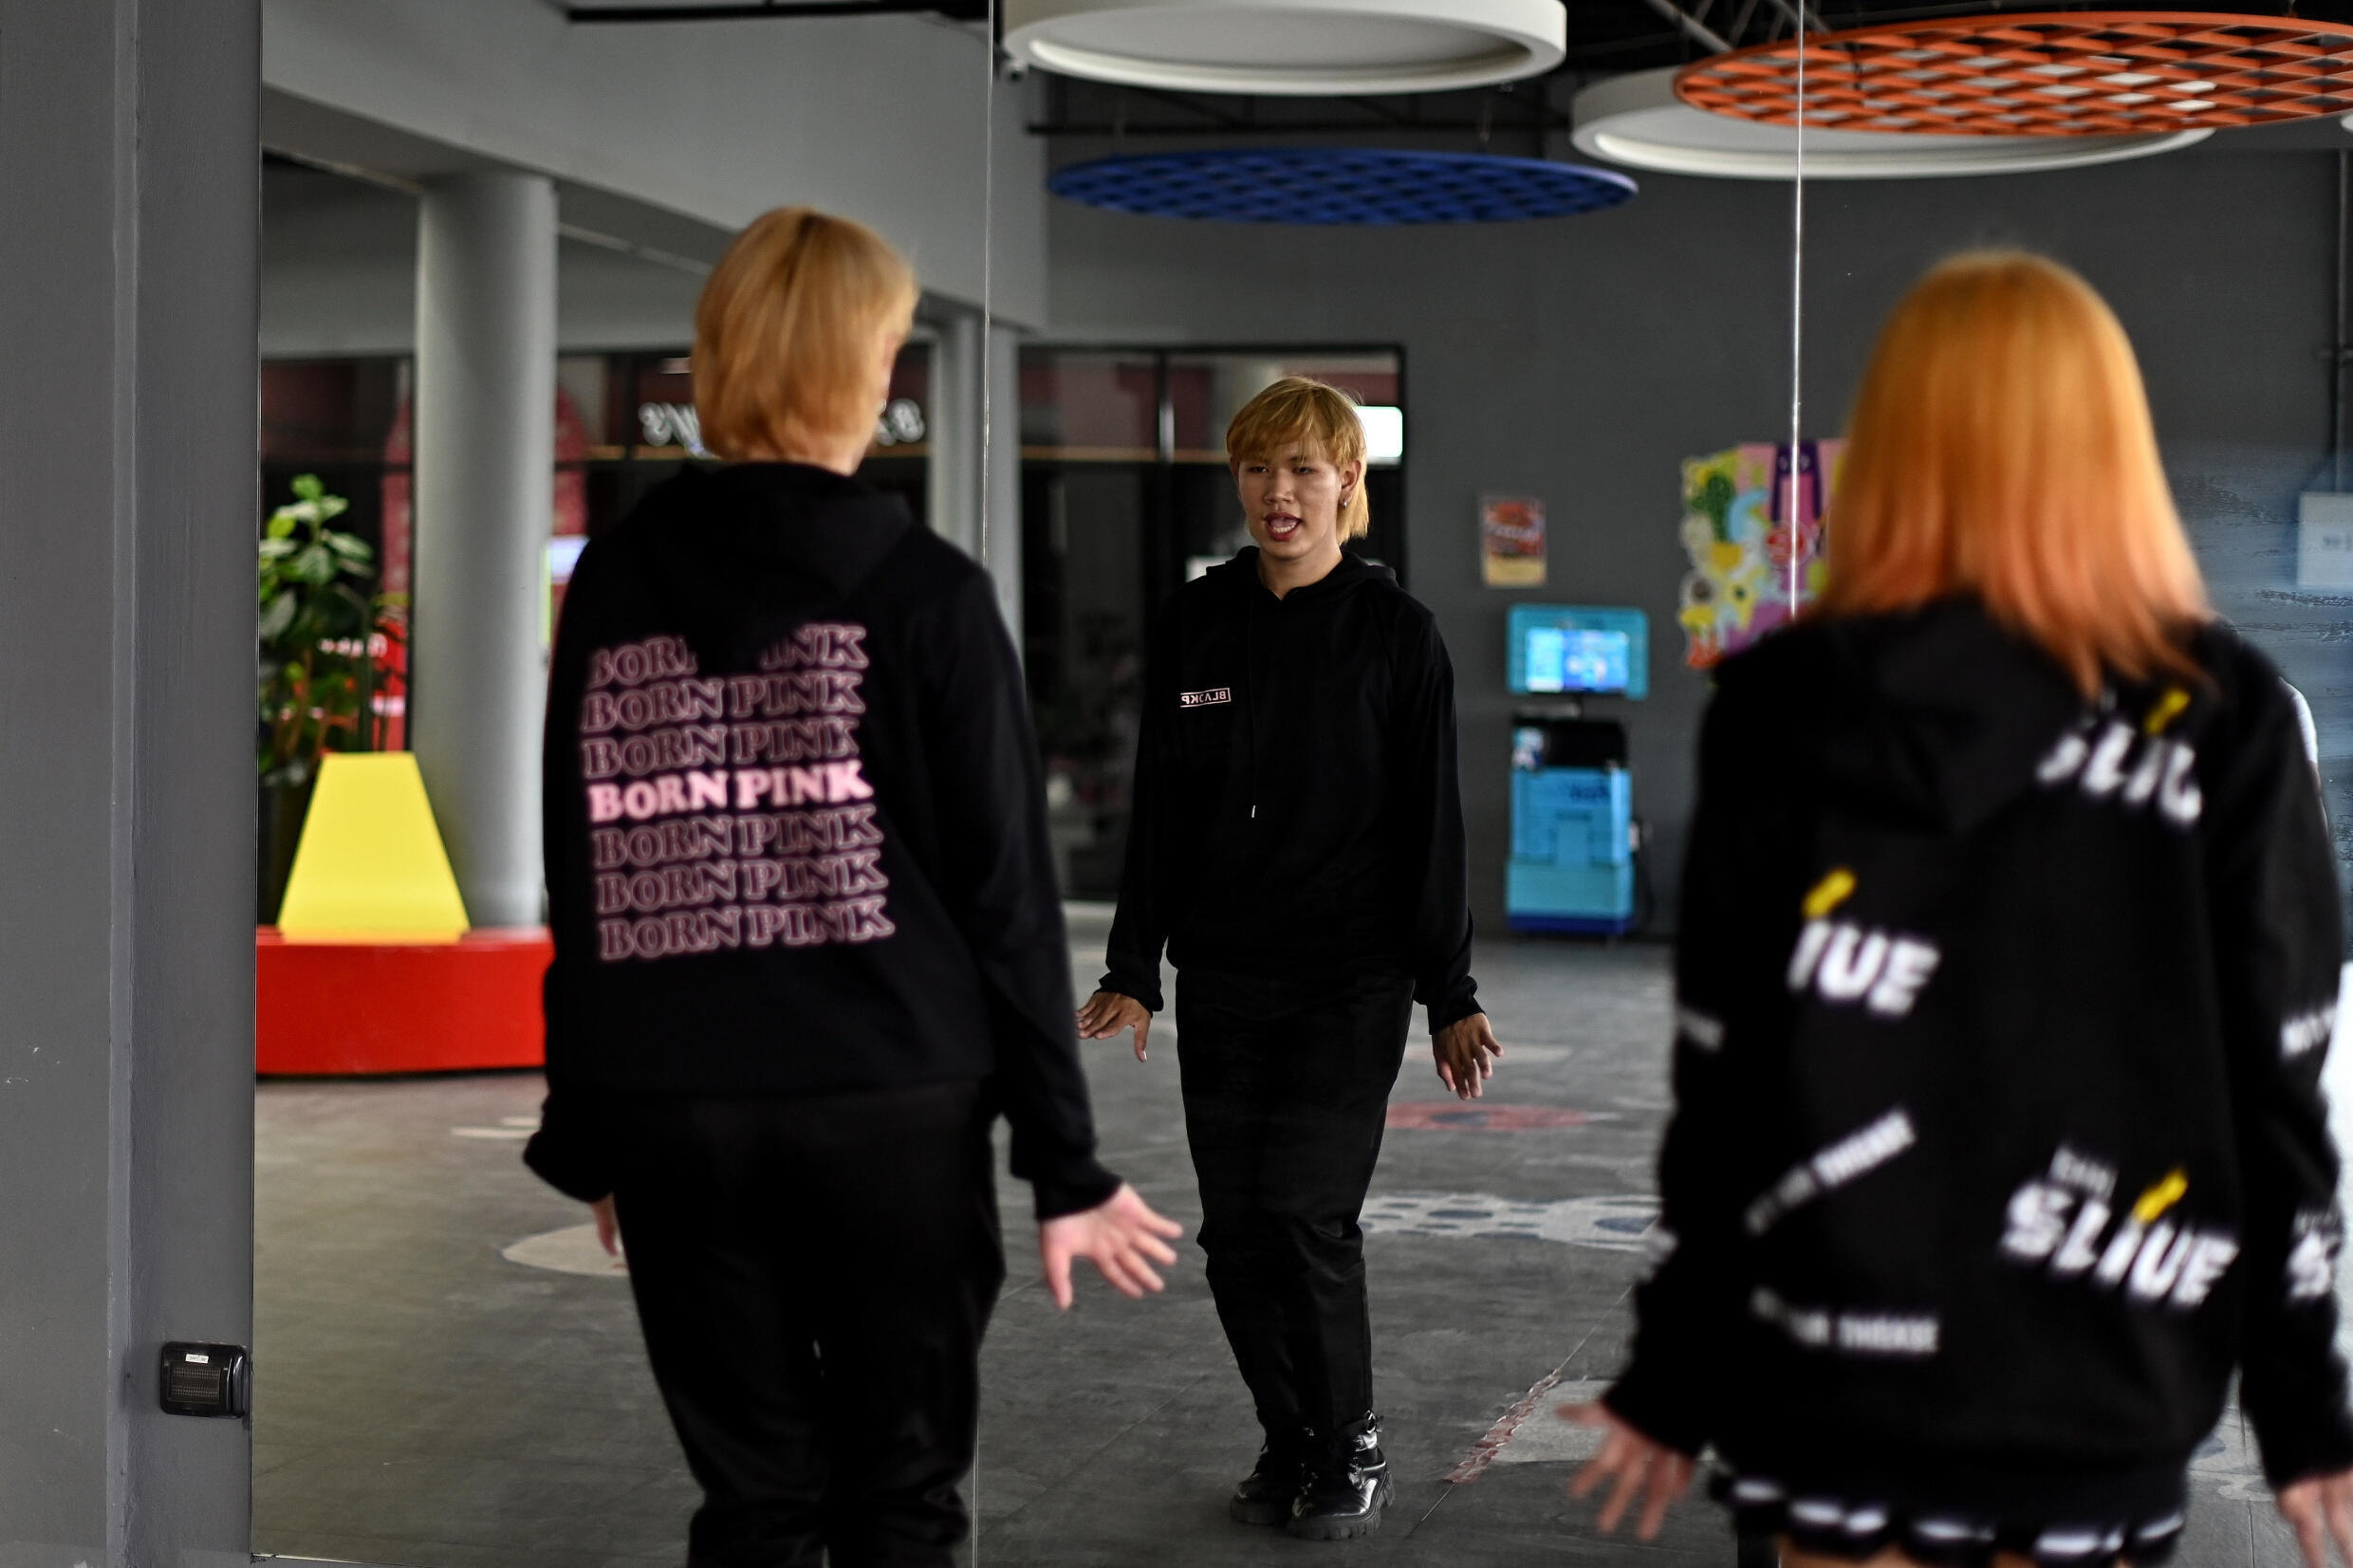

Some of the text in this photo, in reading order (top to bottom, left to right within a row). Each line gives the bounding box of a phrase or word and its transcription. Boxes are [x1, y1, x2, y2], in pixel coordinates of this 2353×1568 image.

[581, 671, 865, 732] BORN PINK
[581, 716, 859, 778] BORN PINK
[588, 760, 873, 821] BORN PINK
[592, 803, 883, 868] BORN PINK
[596, 848, 888, 913] BORN PINK
[599, 895, 895, 960] BORN PINK
